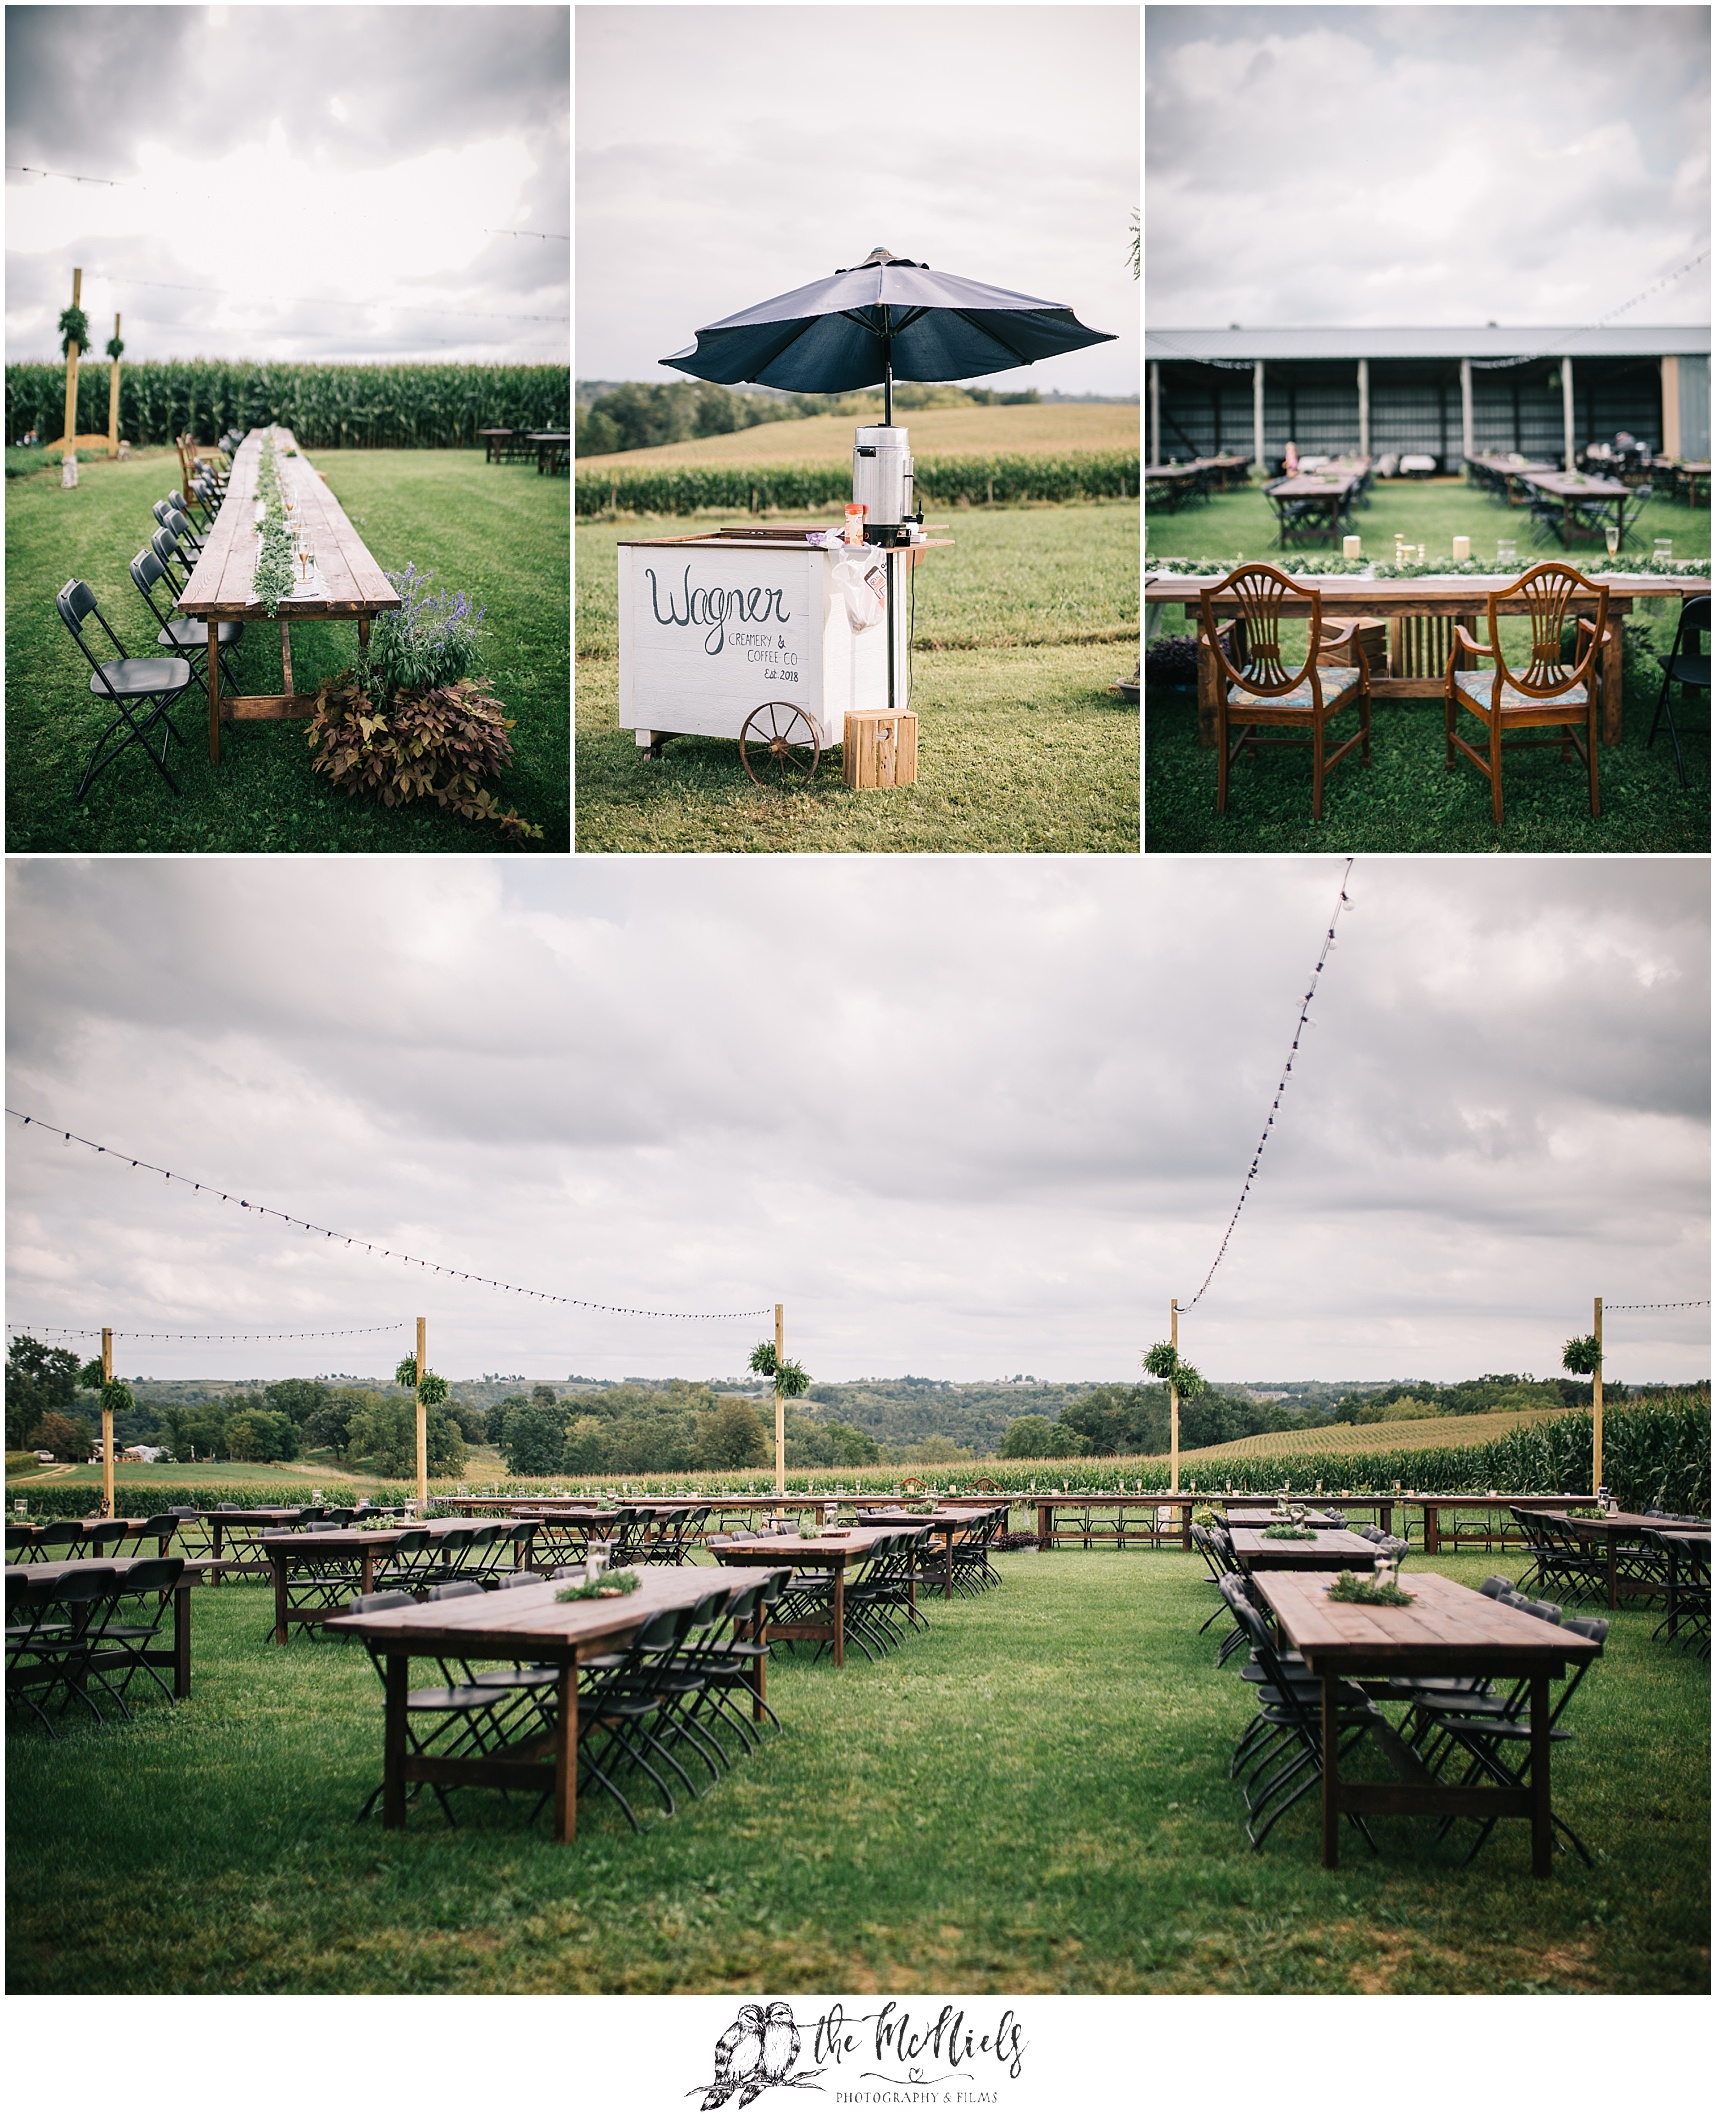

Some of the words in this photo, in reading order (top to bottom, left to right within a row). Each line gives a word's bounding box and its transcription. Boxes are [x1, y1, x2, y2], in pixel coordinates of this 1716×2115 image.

[645, 564, 791, 656] Wagner
[728, 632, 773, 648] CREAMERY
[777, 634, 787, 649] &
[747, 649, 779, 664] COFFEE
[783, 652, 798, 666] CO
